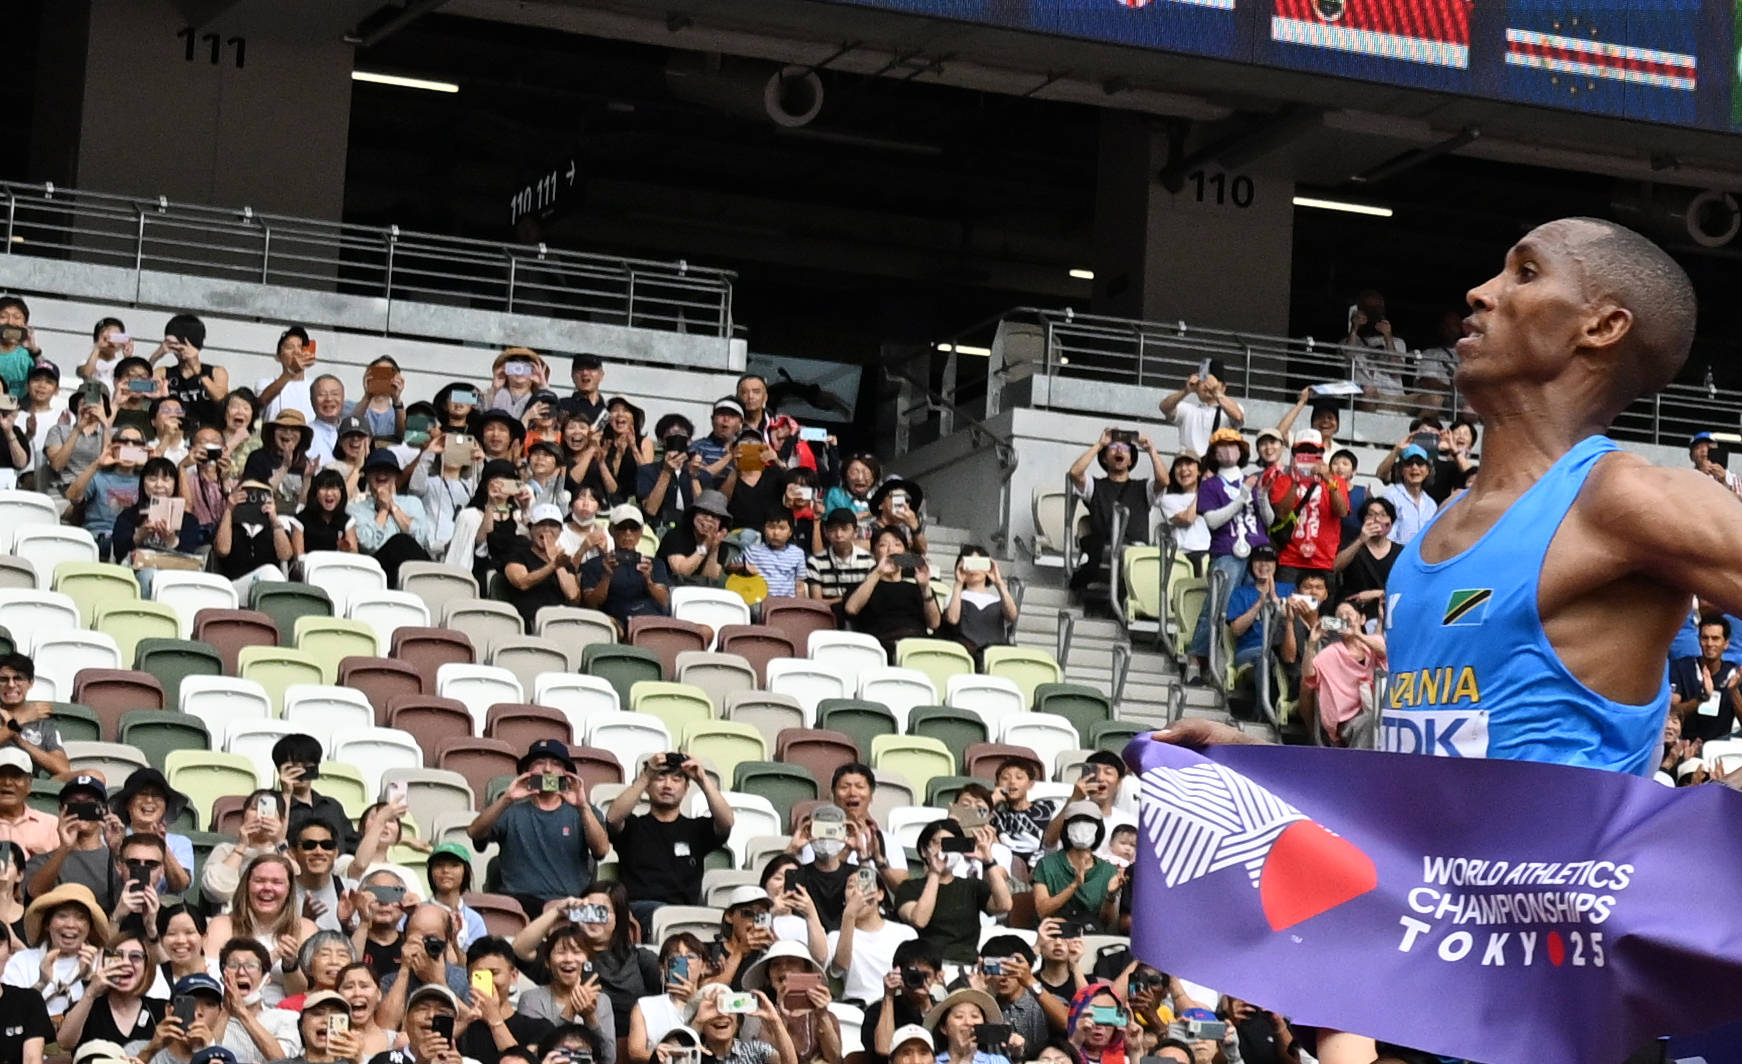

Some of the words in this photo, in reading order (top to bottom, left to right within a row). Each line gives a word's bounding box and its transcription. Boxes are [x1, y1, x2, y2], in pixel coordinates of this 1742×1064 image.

[177, 28, 245, 69] 111
[537, 170, 557, 210] 111
[1189, 170, 1255, 208] 110
[1423, 856, 1509, 886] WORLD
[1503, 860, 1634, 891] ATHLETICS
[1407, 887, 1616, 925] CHAMPIONSHIPS
